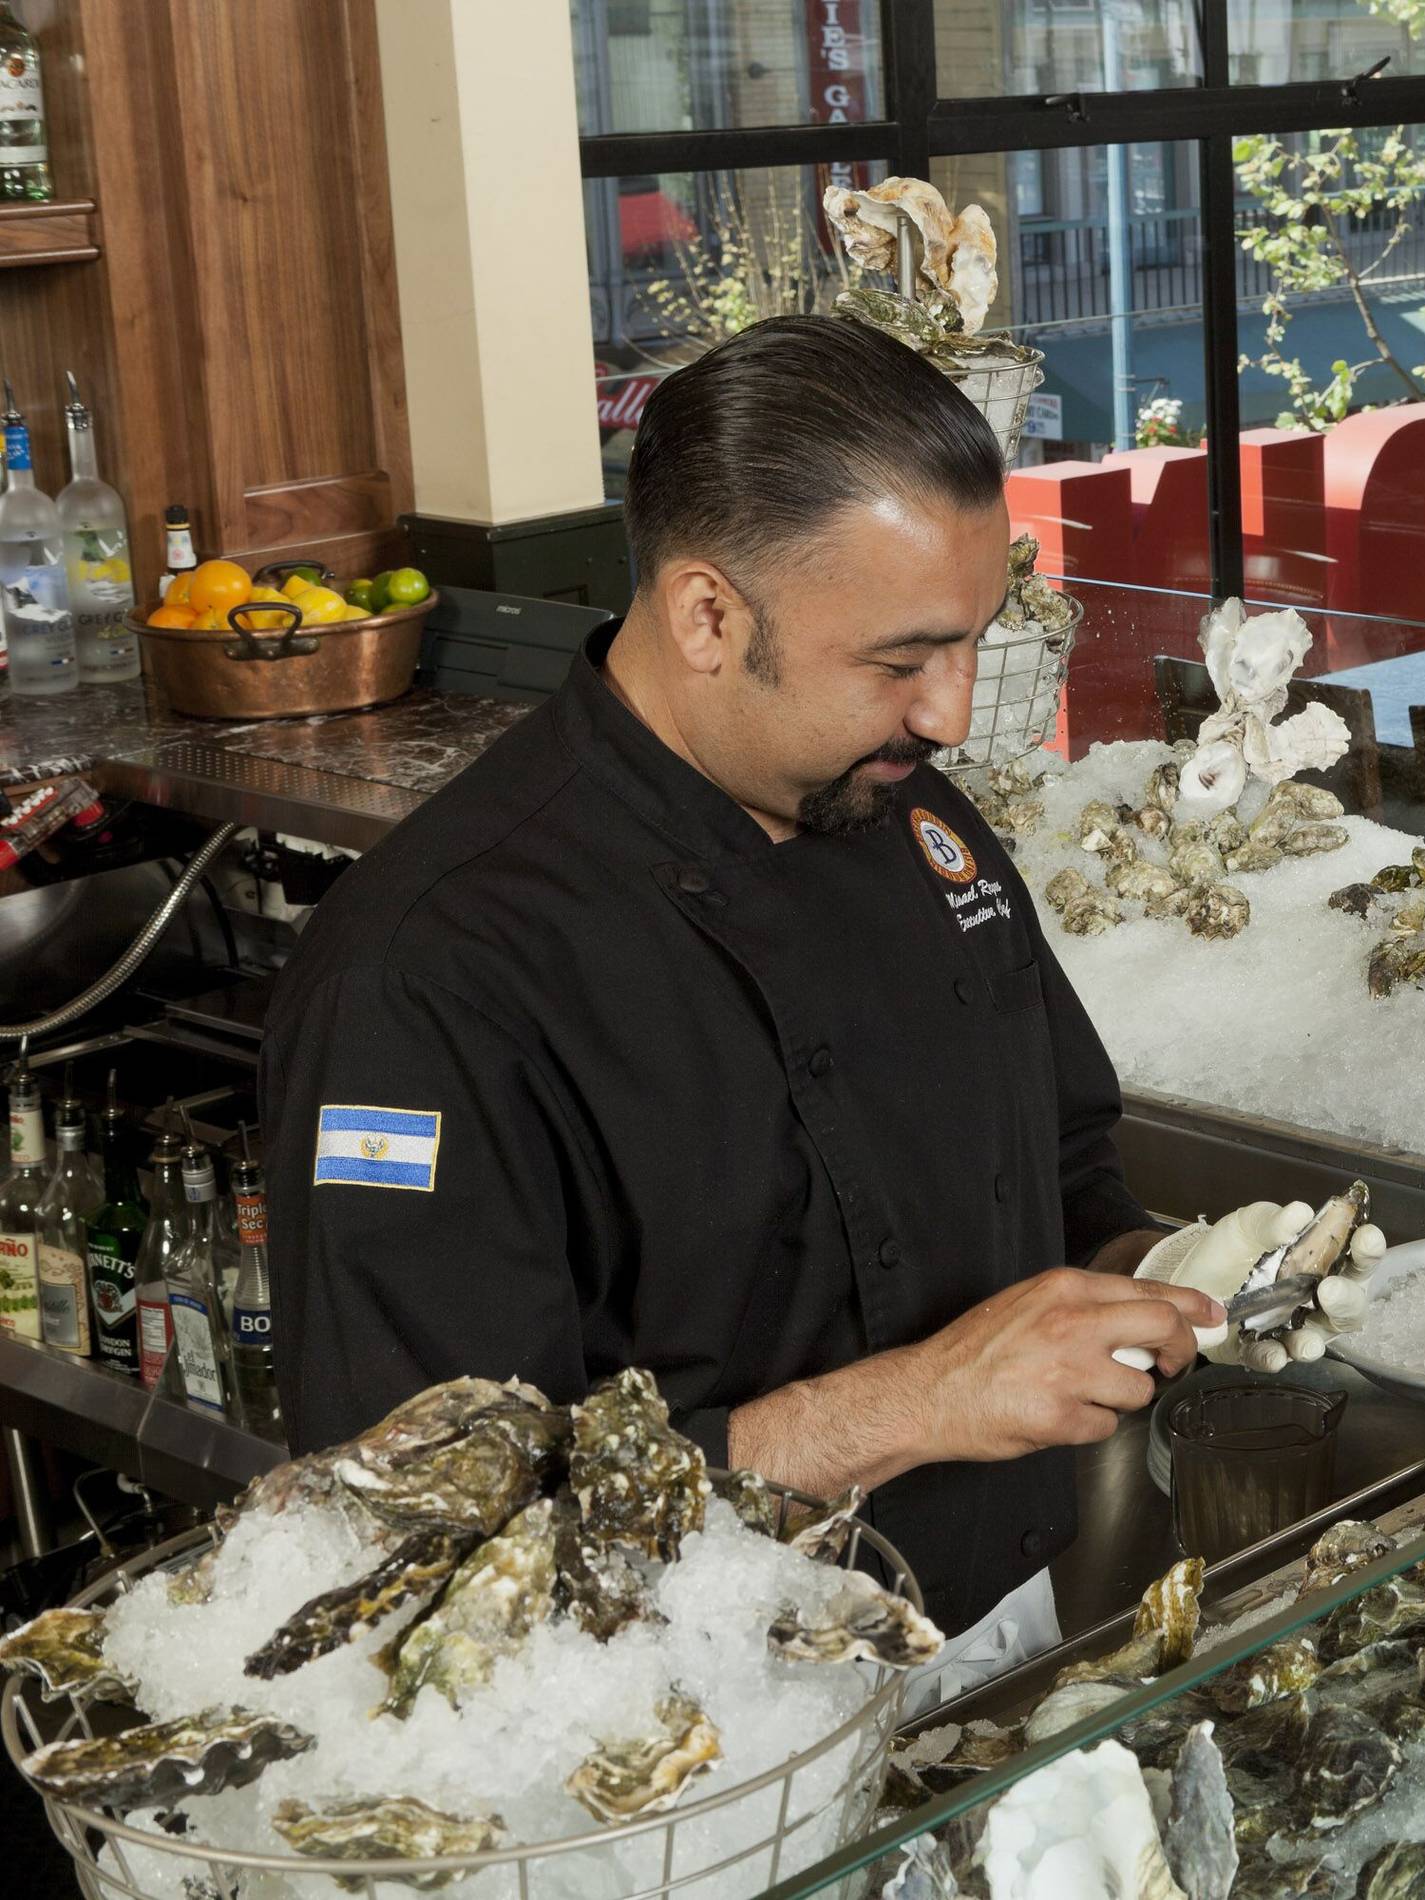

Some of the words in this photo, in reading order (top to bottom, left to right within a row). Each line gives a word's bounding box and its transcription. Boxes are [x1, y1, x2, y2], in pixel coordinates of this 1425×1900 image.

[821, 0, 850, 70] IE'S
[241, 1218, 264, 1230] Sec
[240, 1315, 271, 1333] BO
